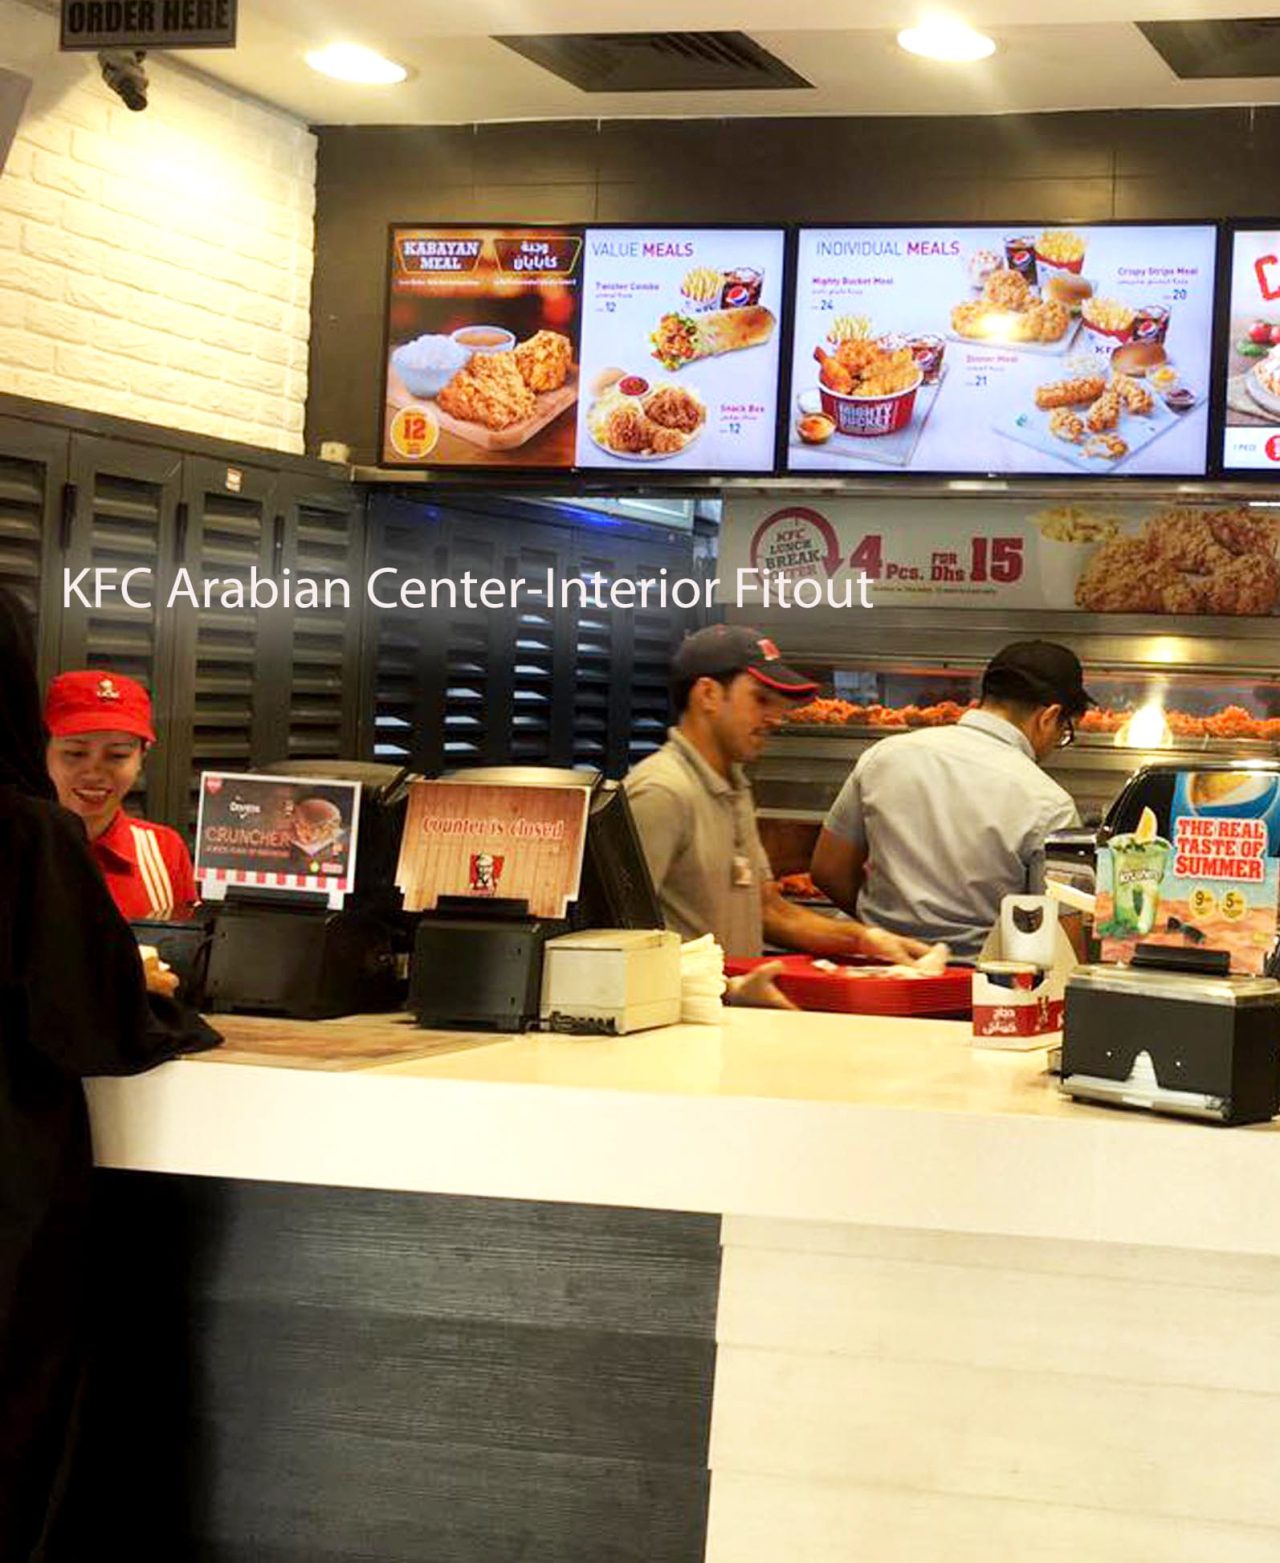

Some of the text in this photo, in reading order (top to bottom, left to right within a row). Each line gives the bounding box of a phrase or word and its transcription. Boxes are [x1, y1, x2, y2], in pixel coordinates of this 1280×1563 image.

[68, 0, 229, 33] ORDER HERE
[403, 241, 479, 256] KABAYAN
[592, 242, 694, 257] VALUE MEALS
[816, 240, 960, 256] INDIVIDUAL MEALS
[420, 257, 462, 270] MEAL
[1177, 267, 1199, 275] Meal
[812, 277, 893, 286] Mighty Bucket Meal
[1173, 289, 1187, 300] 20
[820, 300, 834, 310] 24
[975, 375, 988, 386] 21
[403, 418, 426, 440] 12
[776, 529, 806, 542] KFC
[770, 540, 812, 555] LUNCH
[765, 549, 821, 570] BREAK
[849, 535, 924, 581] 4 Pcs.
[931, 552, 957, 565] FOR
[931, 537, 1024, 583] Dhs 15
[422, 816, 485, 836] Counter
[490, 818, 503, 833] is
[1177, 818, 1264, 840] THE REAL
[204, 825, 292, 848] CRUNCHER
[1177, 837, 1263, 857] TASTE OF
[1175, 856, 1262, 879] SUMMER
[1195, 890, 1205, 906] 9
[1225, 892, 1235, 908] 5
